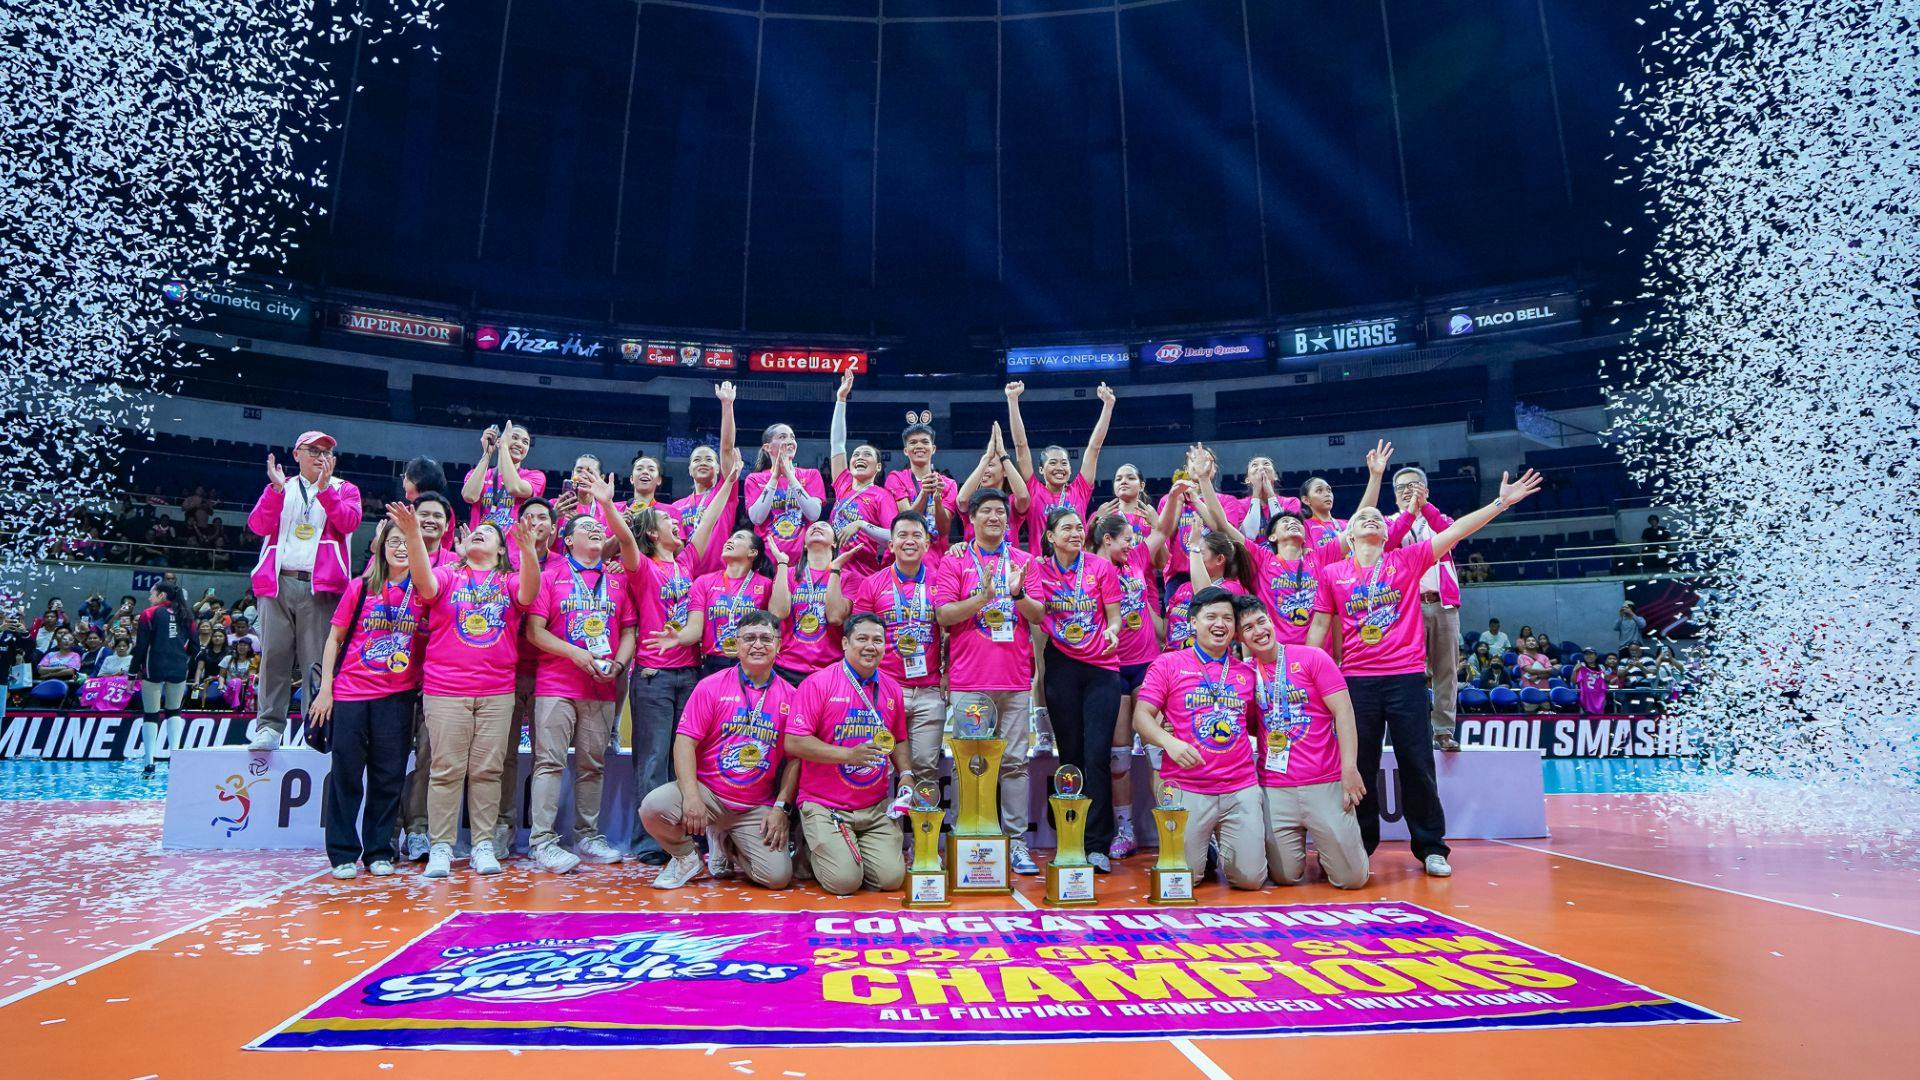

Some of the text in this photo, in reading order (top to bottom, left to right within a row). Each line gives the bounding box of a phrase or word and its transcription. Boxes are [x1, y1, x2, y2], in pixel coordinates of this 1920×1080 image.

[193, 289, 301, 321] araneta city
[1475, 306, 1555, 328] TACO BELL
[339, 312, 451, 341] EMPERADOR
[1332, 323, 1397, 350] VERSE
[500, 327, 601, 357] Pizza Hut
[1161, 348, 1179, 360] DQ
[1185, 345, 1250, 358] Dairy Queen
[649, 353, 674, 363] Cignal
[707, 357, 731, 367] Cignal
[847, 355, 859, 371] 2
[1008, 352, 1130, 366] GATEWAY CINEPLEX 18
[1329, 437, 1344, 447] 219
[134, 575, 163, 588] 112
[103, 687, 125, 703] 23
[1460, 719, 1547, 757] COOL
[814, 907, 1429, 935] CONGRATULATIONS
[814, 934, 1508, 967] 2024 GRAND SLAM
[380, 955, 800, 999] Smashers
[822, 952, 1578, 1005] CHAMPIONS
[879, 991, 1570, 1022] ALL FILIPINO REINFORCED INVITATIONAL
